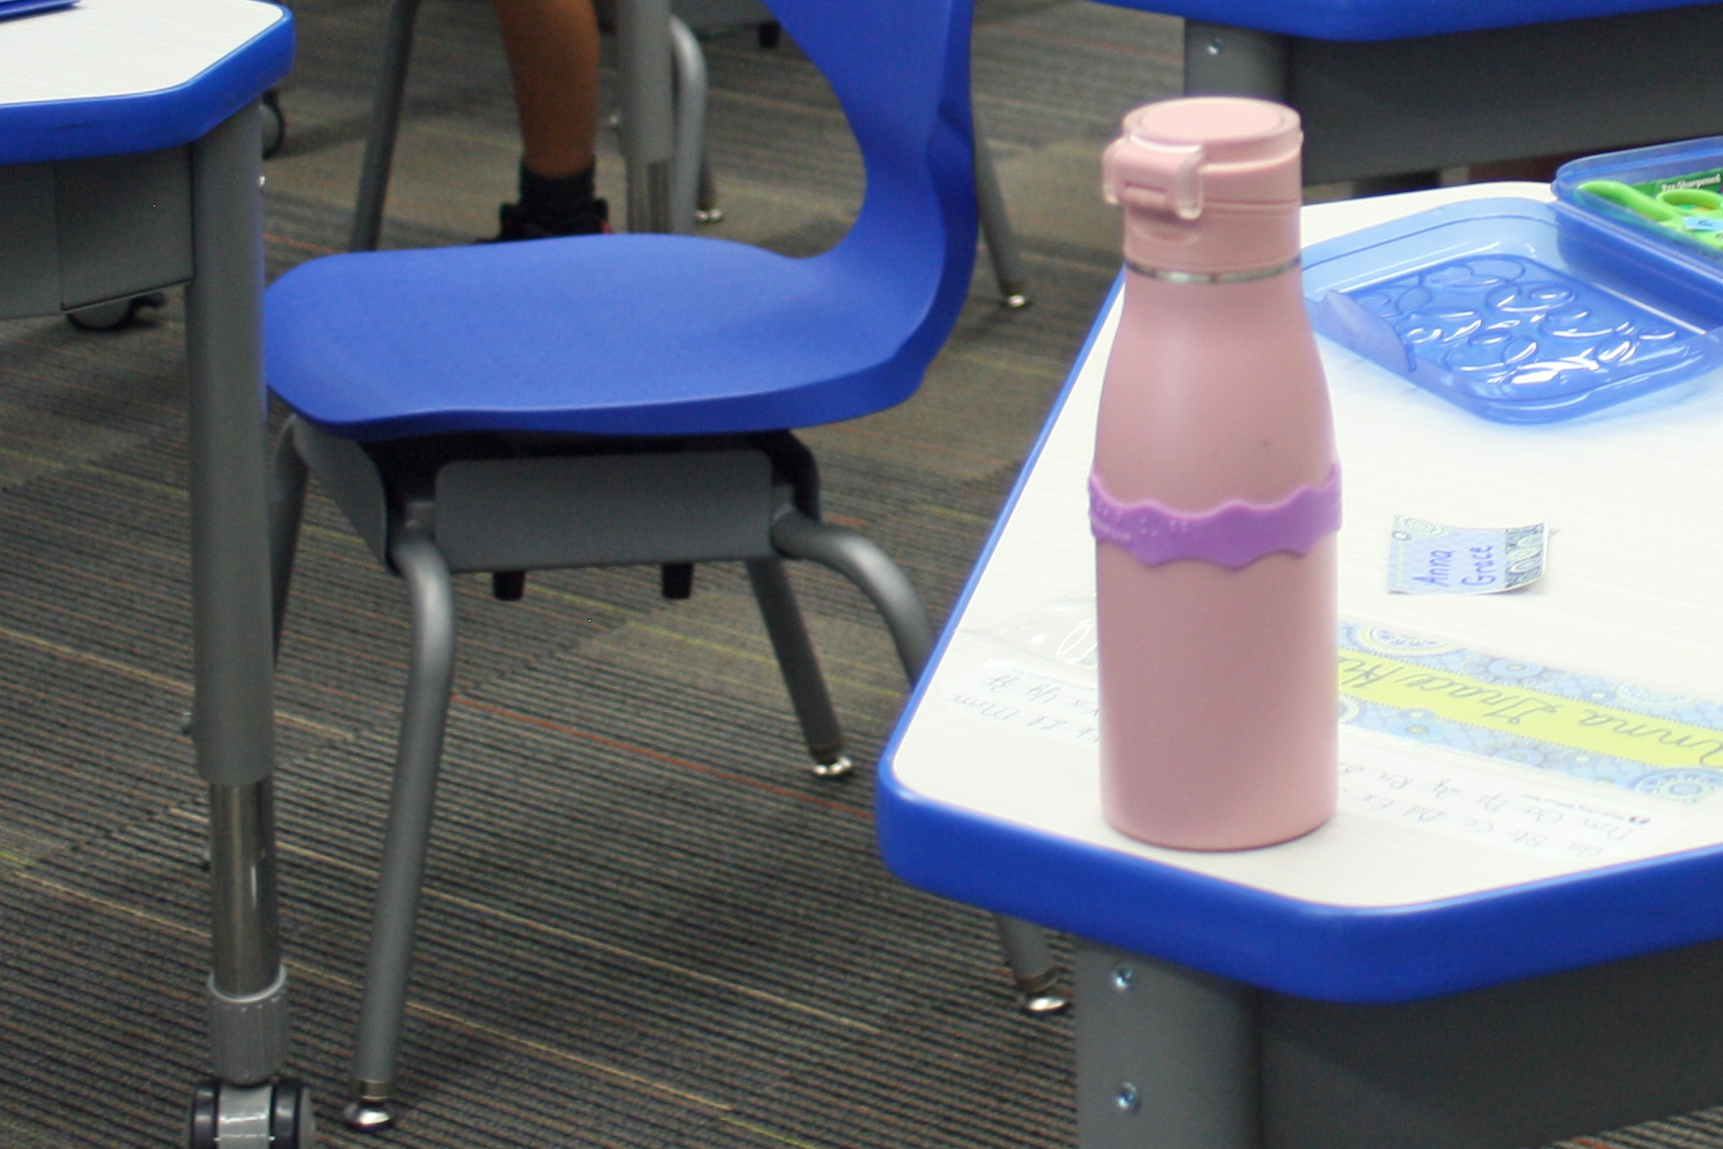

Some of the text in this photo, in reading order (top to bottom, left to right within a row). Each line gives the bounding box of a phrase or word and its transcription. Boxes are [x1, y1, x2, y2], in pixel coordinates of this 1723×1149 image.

[1412, 549, 1456, 588] Anna
[1460, 545, 1498, 587] Grace
[1393, 673, 1565, 726] Grace
